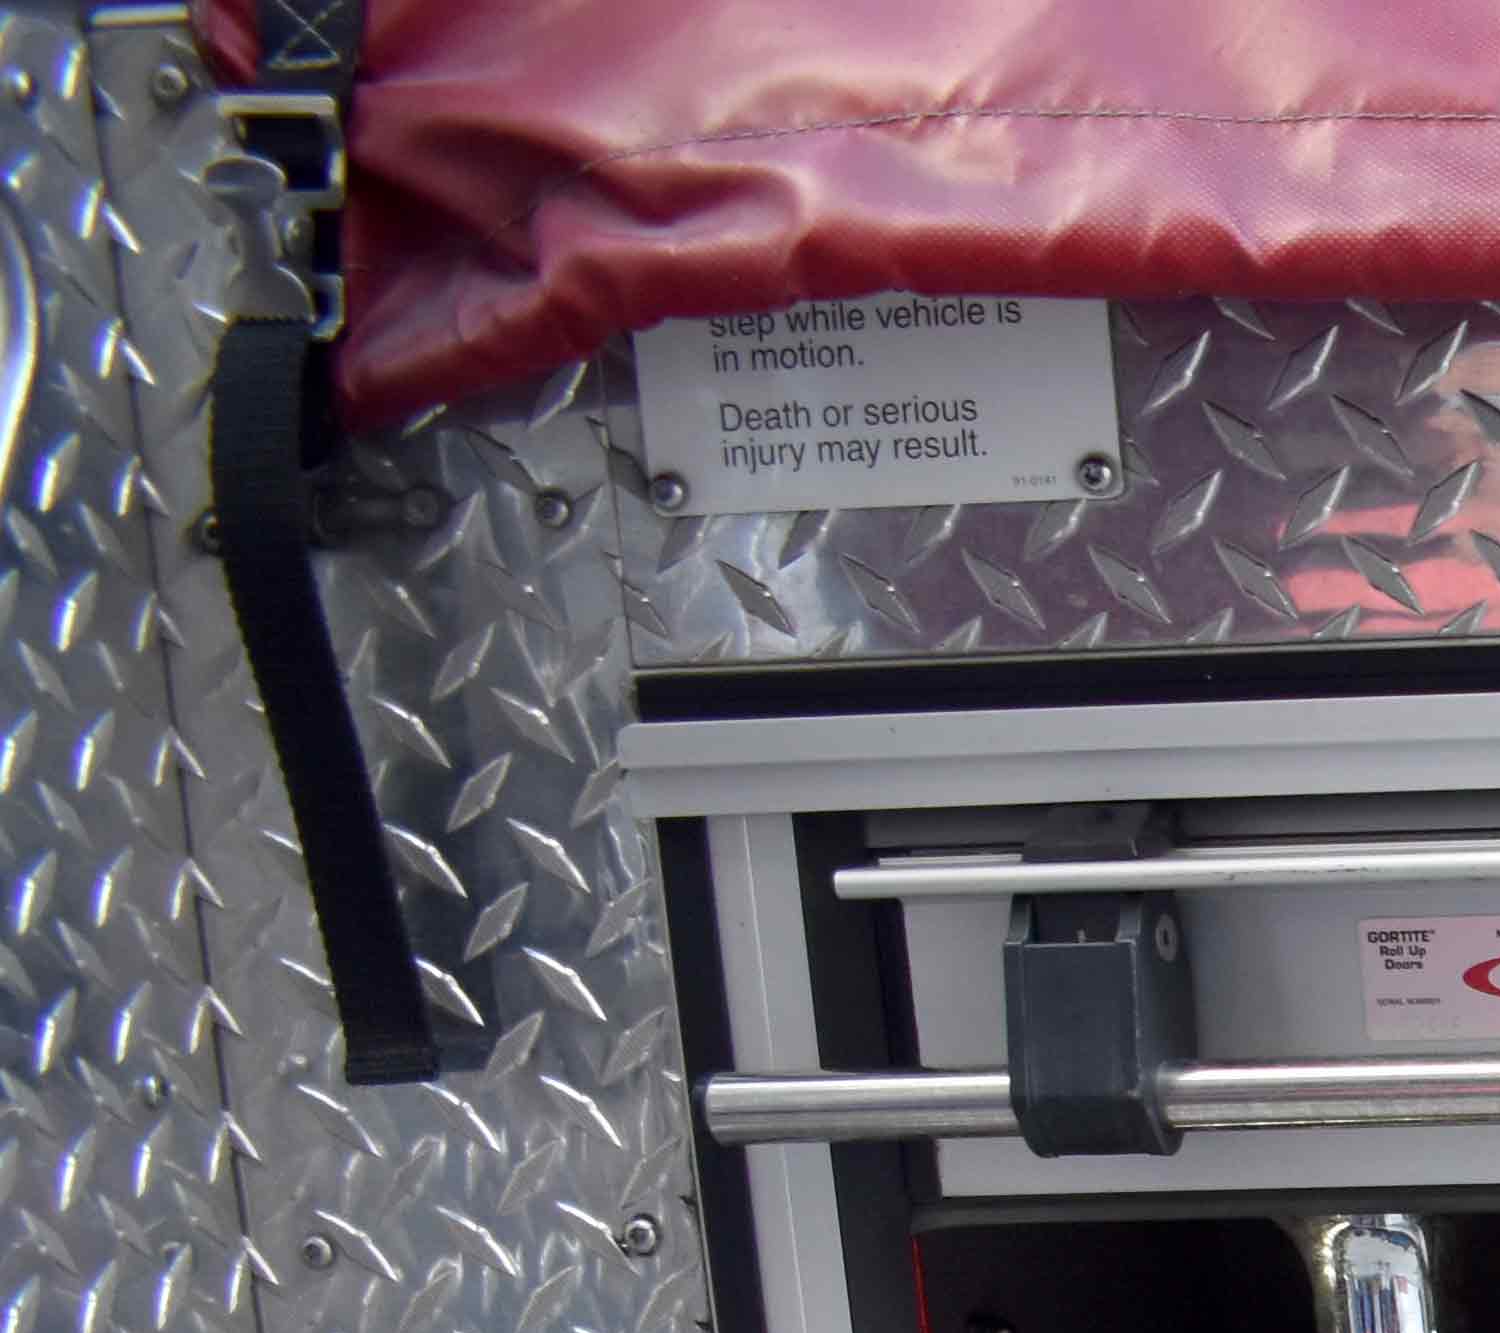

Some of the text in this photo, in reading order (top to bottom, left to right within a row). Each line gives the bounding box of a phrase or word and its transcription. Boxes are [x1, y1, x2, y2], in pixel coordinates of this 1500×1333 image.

[709, 298, 1022, 341] step while vehicle is
[713, 339, 865, 372] in motion.
[720, 395, 979, 432] Death or serious
[721, 429, 988, 475] injury may result.
[1379, 945, 1426, 959] Roll Up
[1384, 959, 1423, 970] Doors
